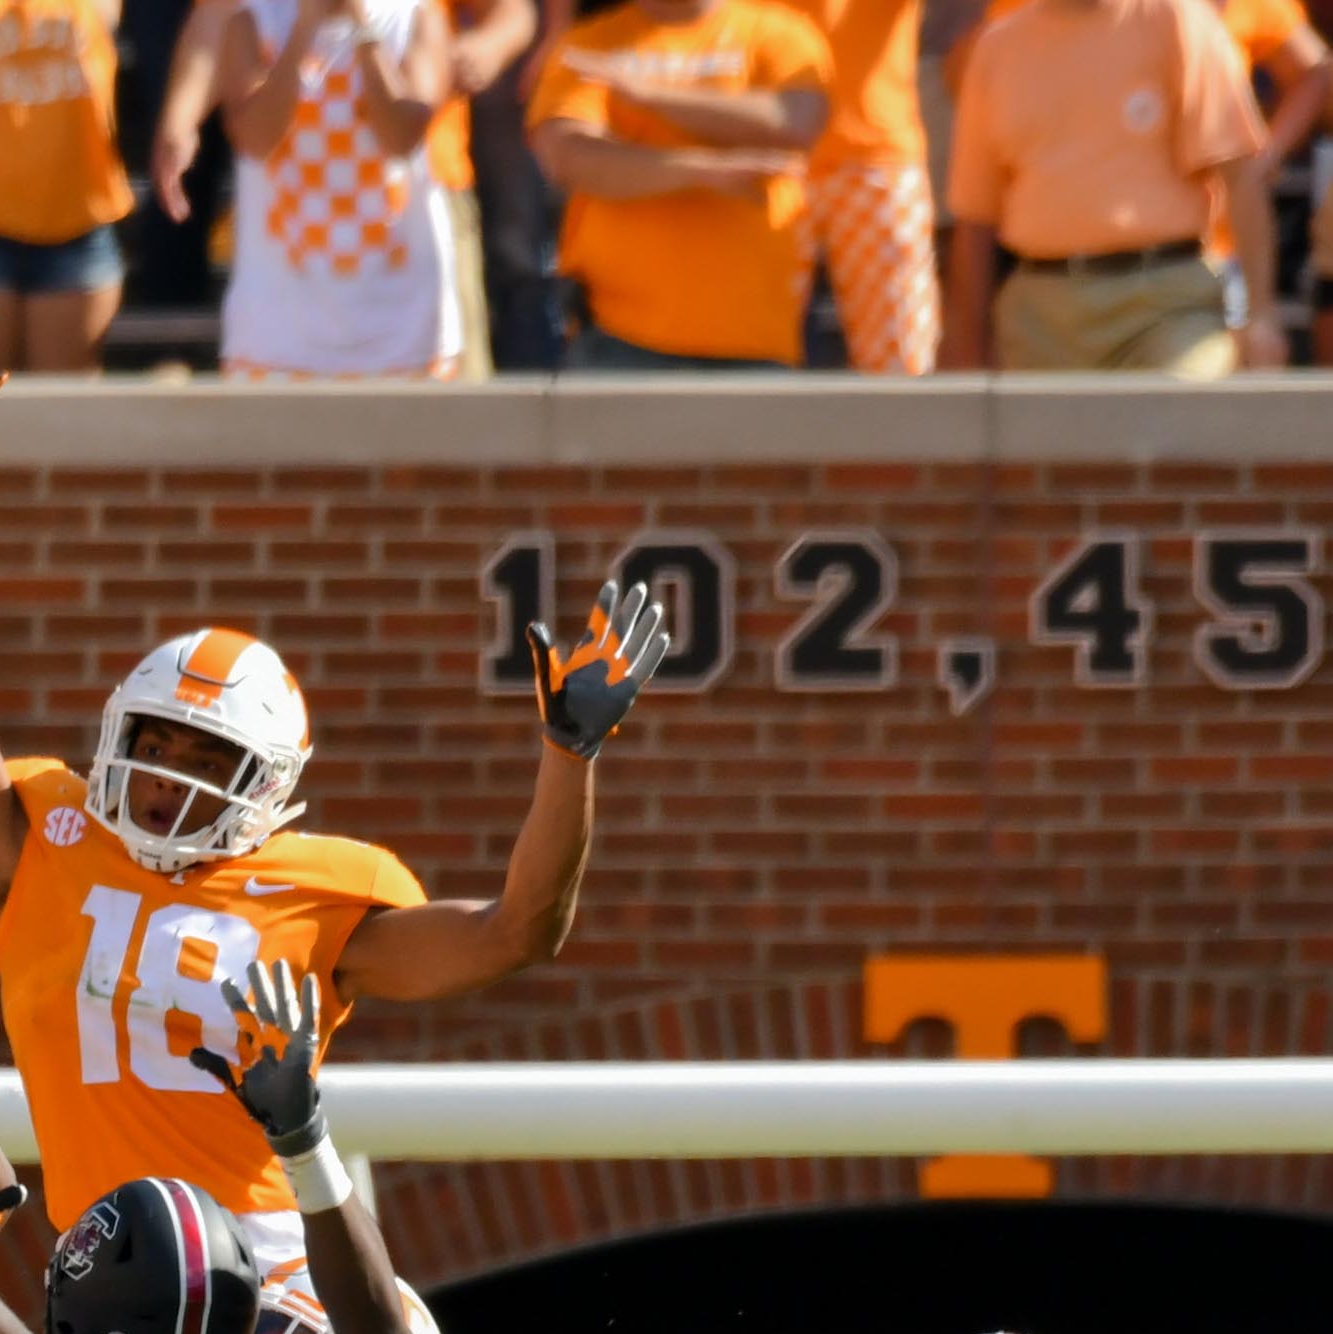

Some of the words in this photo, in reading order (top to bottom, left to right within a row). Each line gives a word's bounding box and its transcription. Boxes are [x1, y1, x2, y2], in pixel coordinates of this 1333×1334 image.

[43, 807, 86, 846] SEC
[76, 884, 261, 1094] 18
[865, 956, 1106, 1200] T
